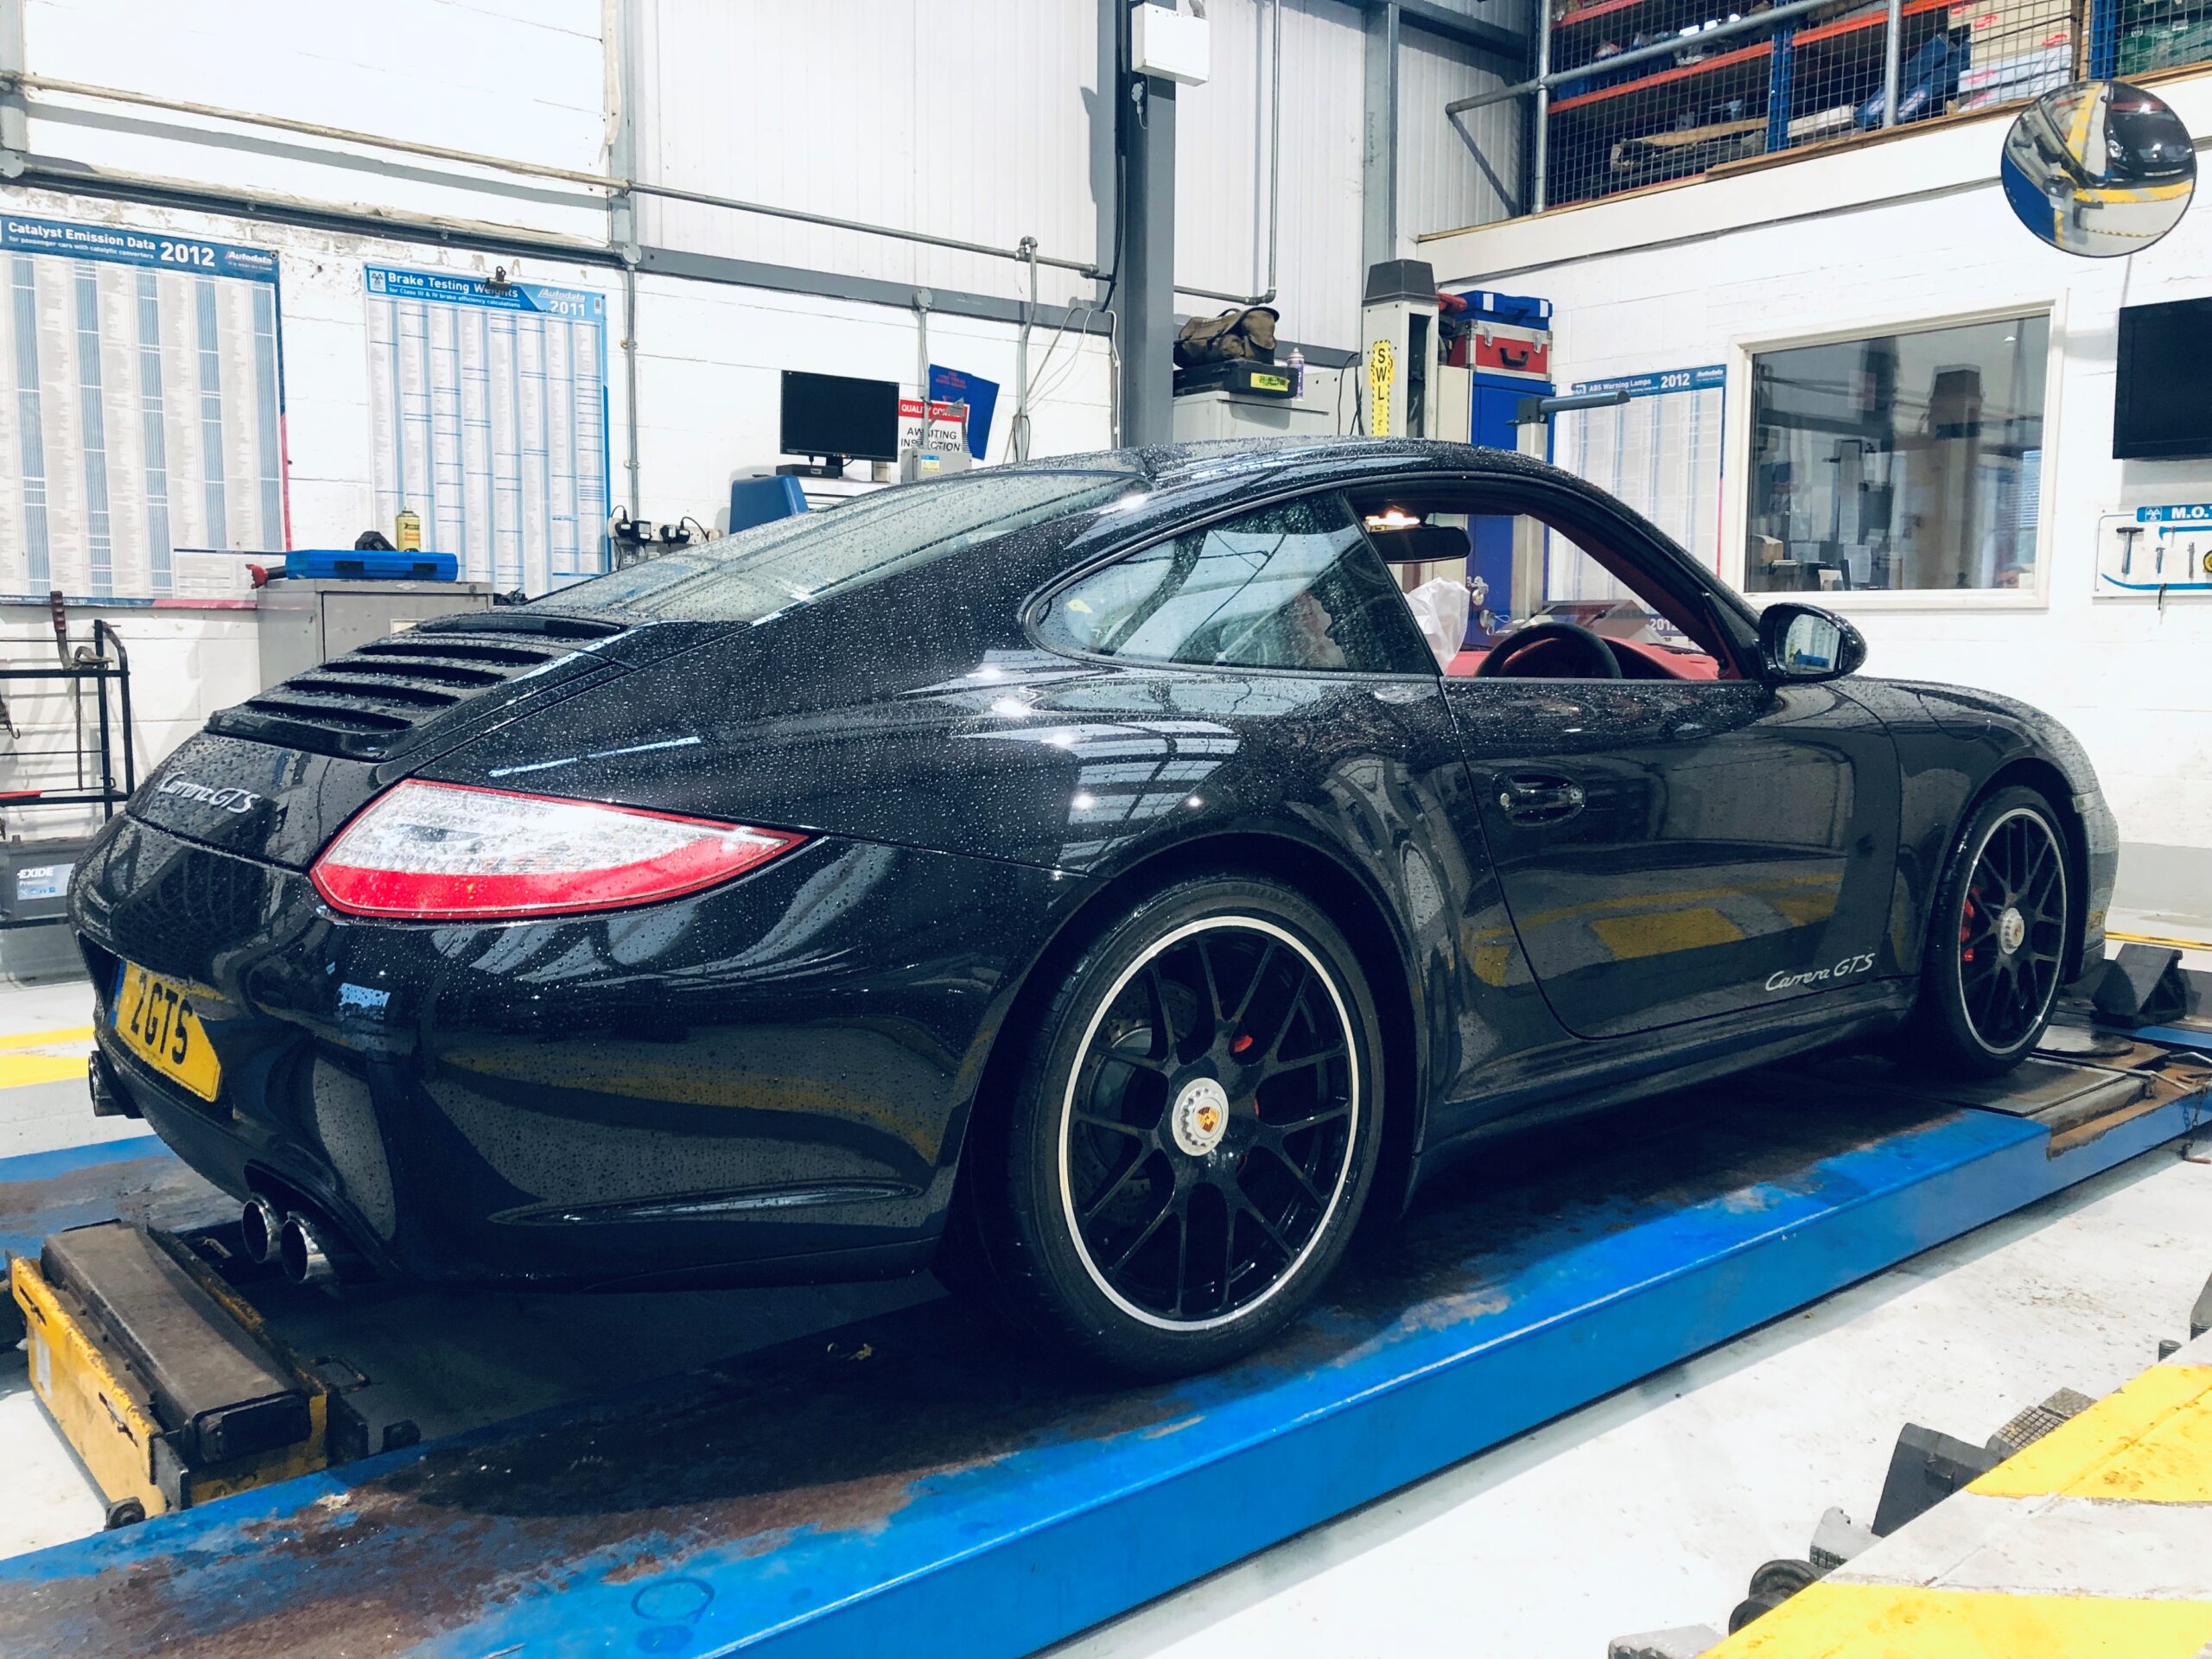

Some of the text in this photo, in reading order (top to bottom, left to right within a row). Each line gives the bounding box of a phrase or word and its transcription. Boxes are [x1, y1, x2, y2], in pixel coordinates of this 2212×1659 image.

[8, 221, 63, 239] Catalyst
[65, 228, 124, 247] Emission
[127, 236, 156, 251] Data
[160, 241, 215, 268] 2012
[90, 245, 118, 255] catalytic
[118, 250, 155, 259] converters
[388, 272, 424, 287] Brake
[428, 276, 470, 295] Testing
[399, 287, 416, 296] Class
[439, 292, 457, 301] brake
[541, 289, 586, 302] Autodata
[550, 300, 586, 317] 2011
[1589, 384, 1602, 392] ABS
[1603, 380, 1630, 391] Warning
[1630, 378, 1651, 388] Lamps
[1660, 372, 1691, 389] 2012
[906, 427, 957, 440] AWITING
[2171, 505, 2212, 519] M.O.
[208, 787, 262, 814] GTS
[19, 867, 54, 879] EXIDE
[1764, 952, 1876, 991] Carrera GTS
